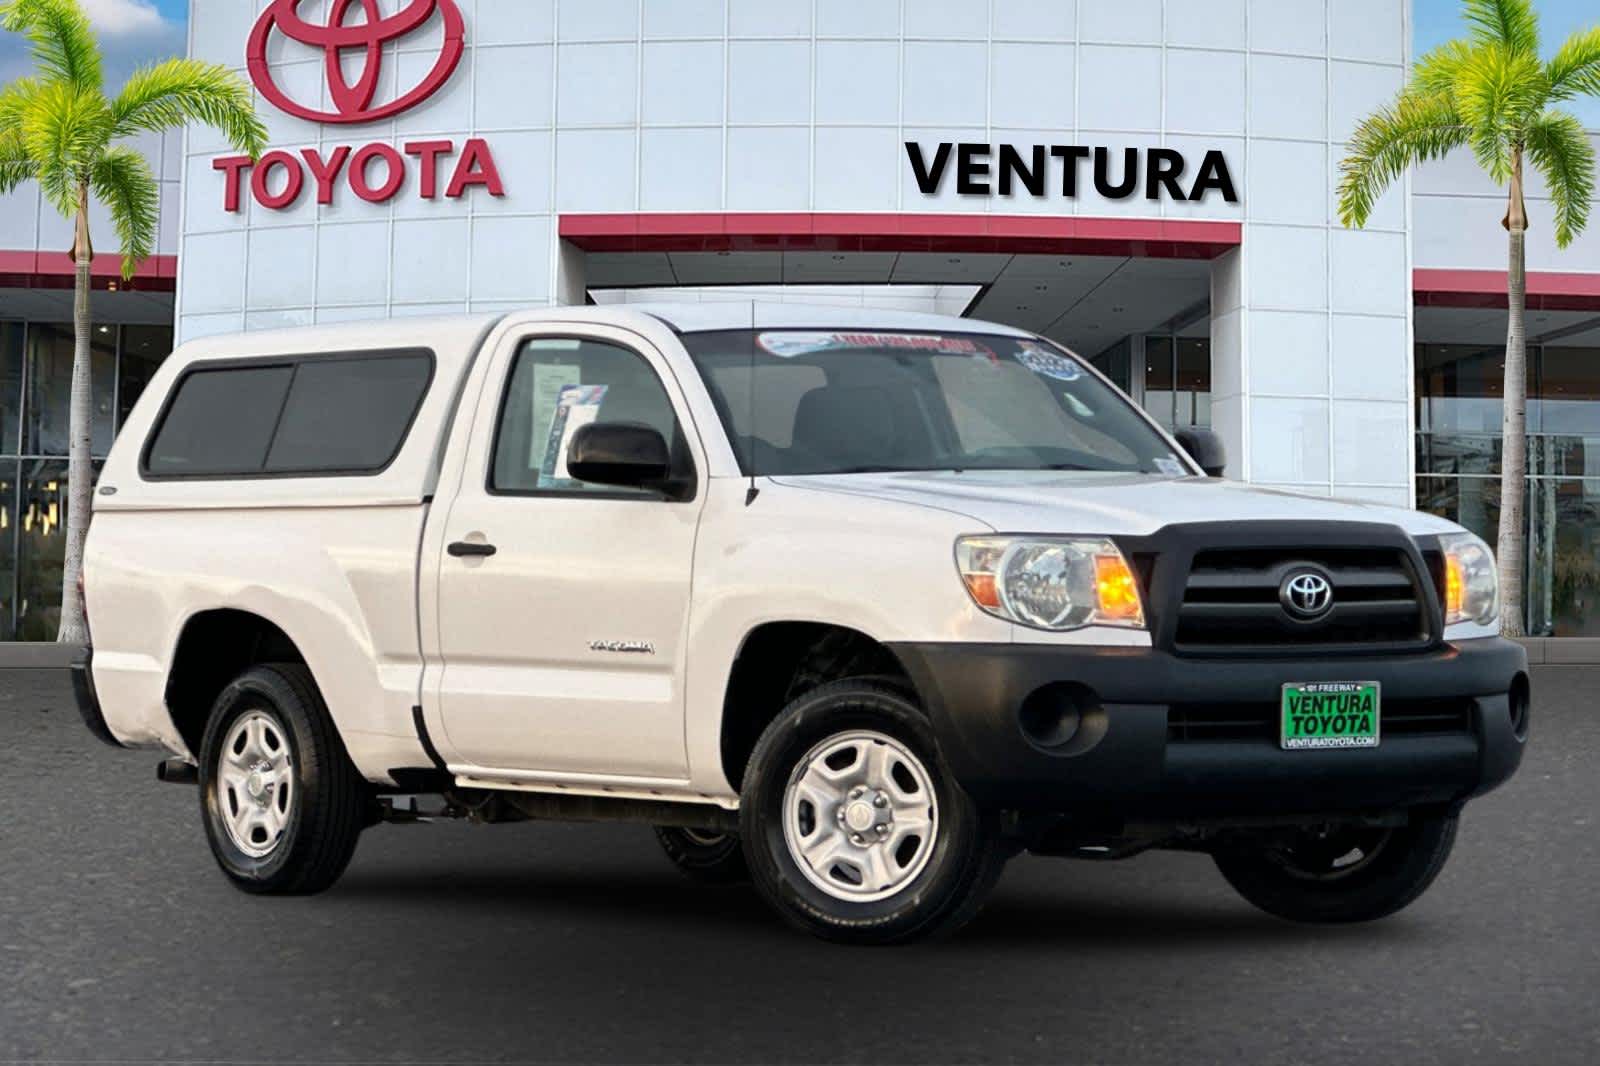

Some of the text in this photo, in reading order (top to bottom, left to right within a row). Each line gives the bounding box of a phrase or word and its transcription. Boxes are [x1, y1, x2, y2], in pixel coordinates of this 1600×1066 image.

[213, 138, 505, 212] TOYOTA
[904, 141, 1239, 203] VENTURA
[1318, 684, 1356, 692] FREEWAY
[1288, 694, 1373, 715] VENTURA
[1292, 714, 1371, 735] TOYOTA
[1286, 737, 1375, 748] VENTURATOYOTA.COM
